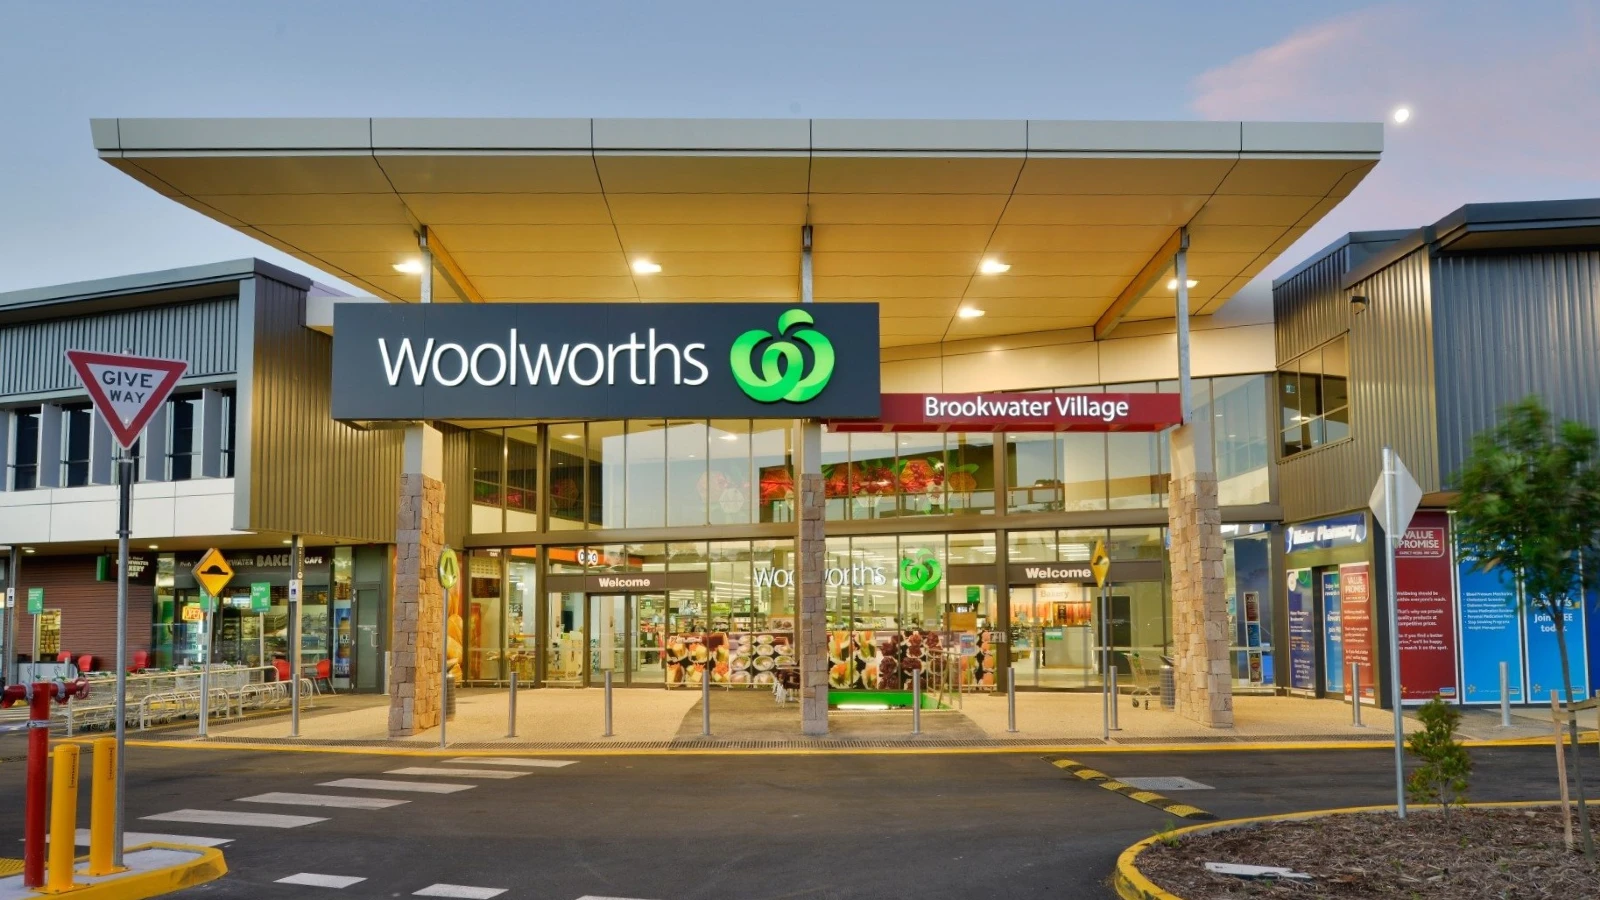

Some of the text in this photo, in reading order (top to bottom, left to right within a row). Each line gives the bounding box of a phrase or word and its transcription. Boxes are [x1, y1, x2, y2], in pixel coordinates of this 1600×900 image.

[378, 328, 708, 387] Woolworths
[102, 370, 153, 388] GIVE
[110, 390, 145, 404] WAY
[925, 396, 1129, 422] Brookwater Village
[1317, 524, 1356, 540] Pharmacy
[1404, 530, 1434, 539] VALUE
[1399, 540, 1440, 548] PROMISE
[1025, 568, 1091, 578] Welcome
[598, 578, 650, 587] Welcome
[1040, 590, 1070, 598] Bakery
[1534, 614, 1551, 623] Join
